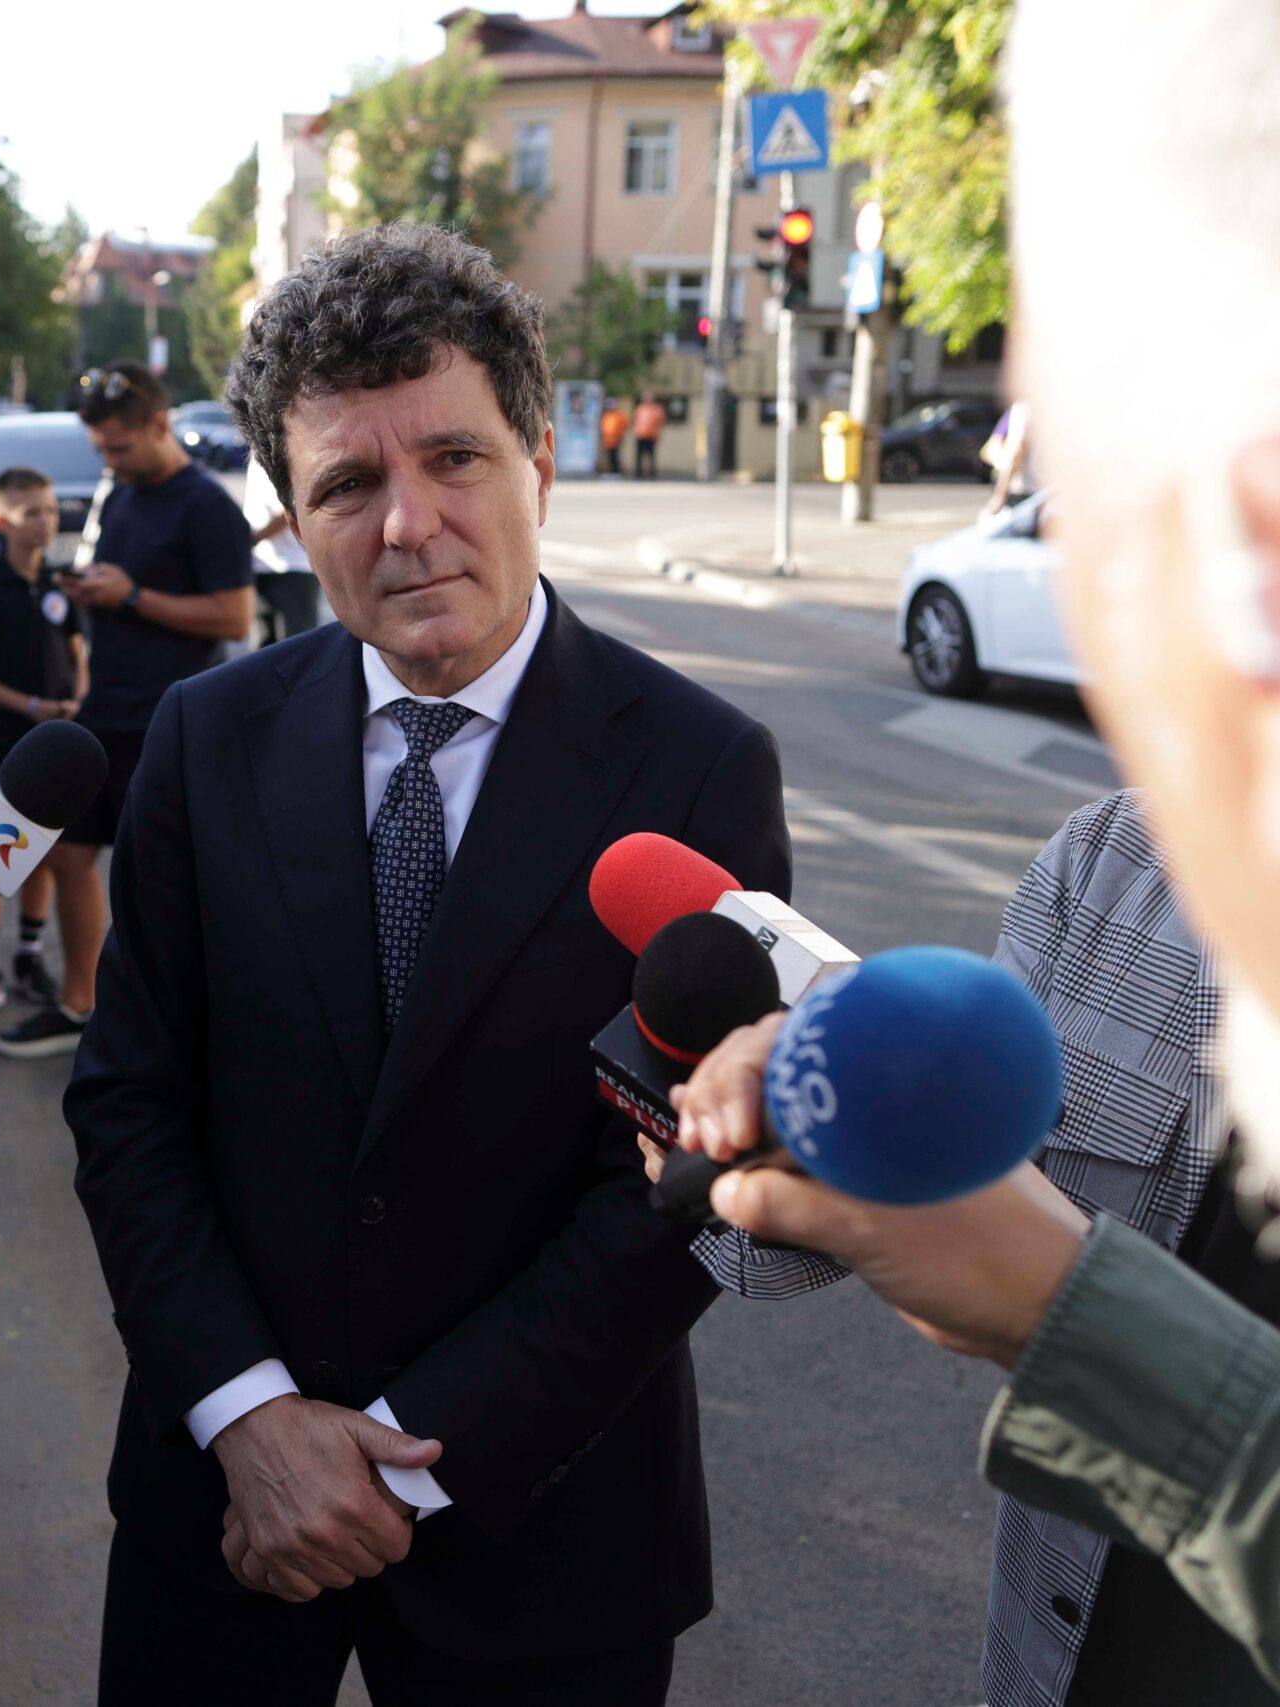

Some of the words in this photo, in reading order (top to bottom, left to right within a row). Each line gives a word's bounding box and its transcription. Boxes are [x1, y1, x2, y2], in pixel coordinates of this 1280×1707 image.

[798, 962, 859, 1123] uro
[595, 1066, 679, 1132] REALITAT
[616, 1094, 681, 1146] PLU
